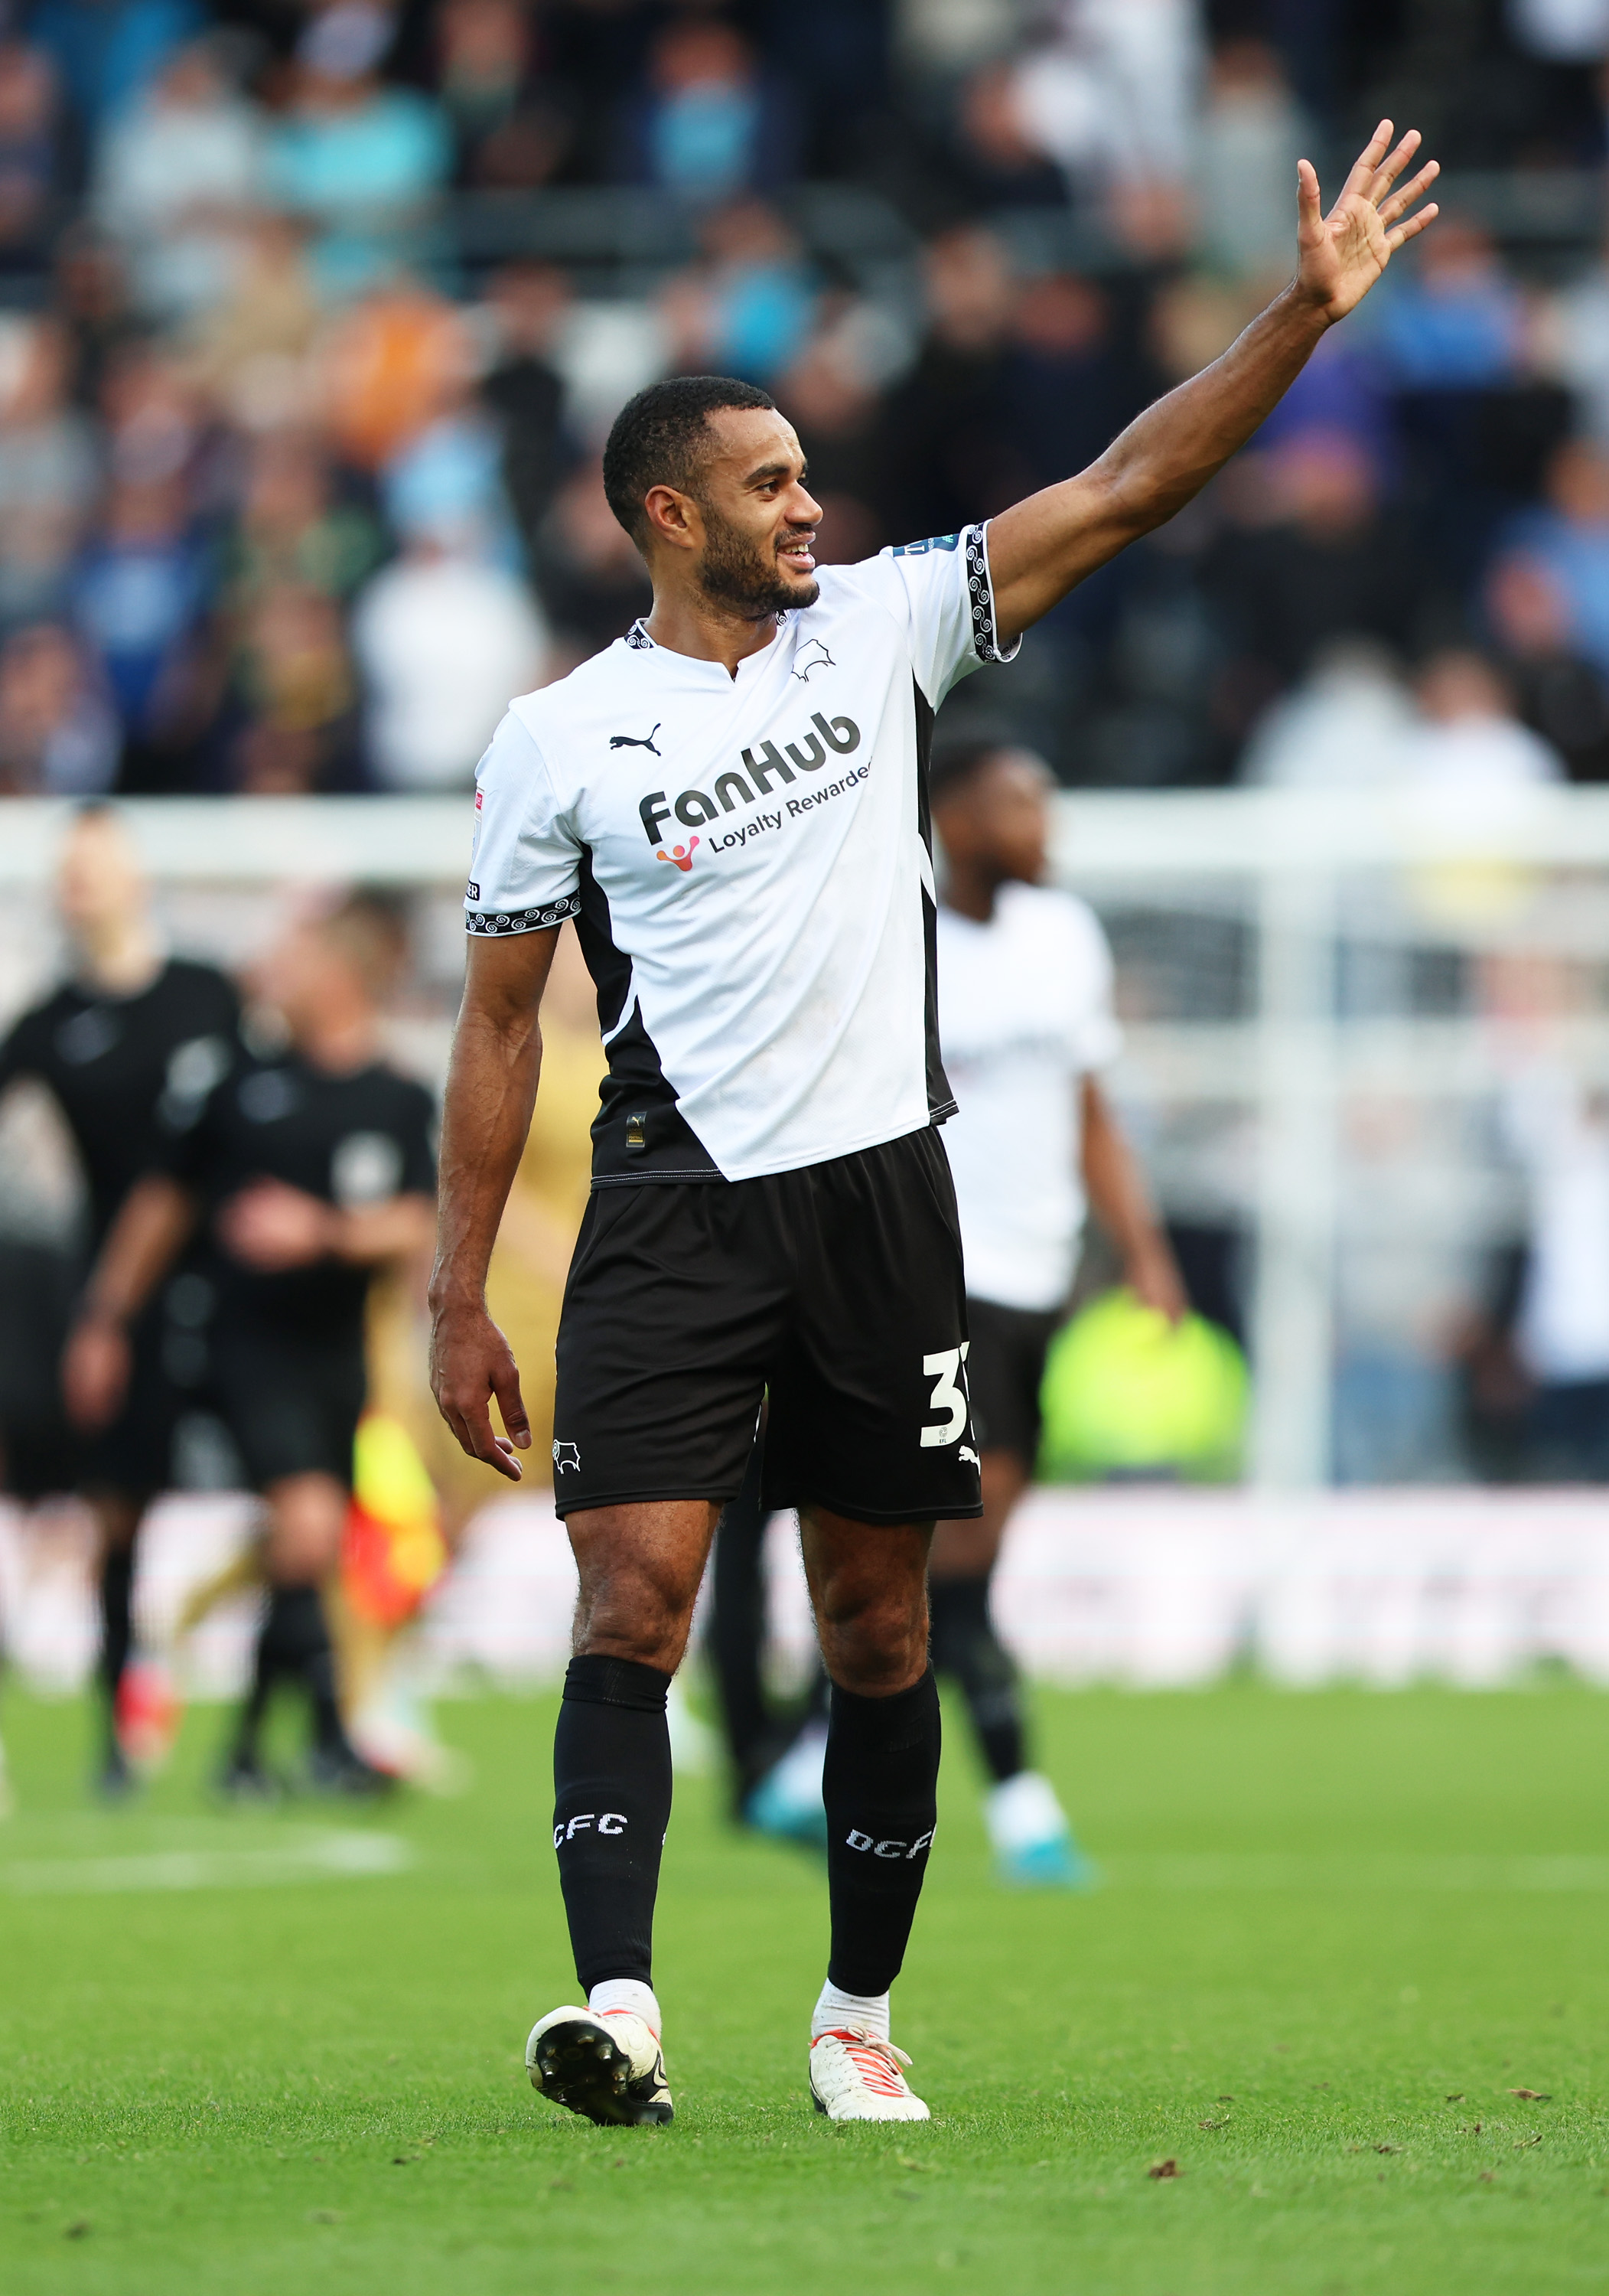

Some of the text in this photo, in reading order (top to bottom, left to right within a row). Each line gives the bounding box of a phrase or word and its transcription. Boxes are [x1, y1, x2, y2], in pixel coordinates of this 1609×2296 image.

[639, 712, 861, 846] FanHub
[708, 755, 872, 853] Loyalty Rewarde
[920, 1341, 975, 1447] 3
[845, 1823, 937, 1859] DCF
